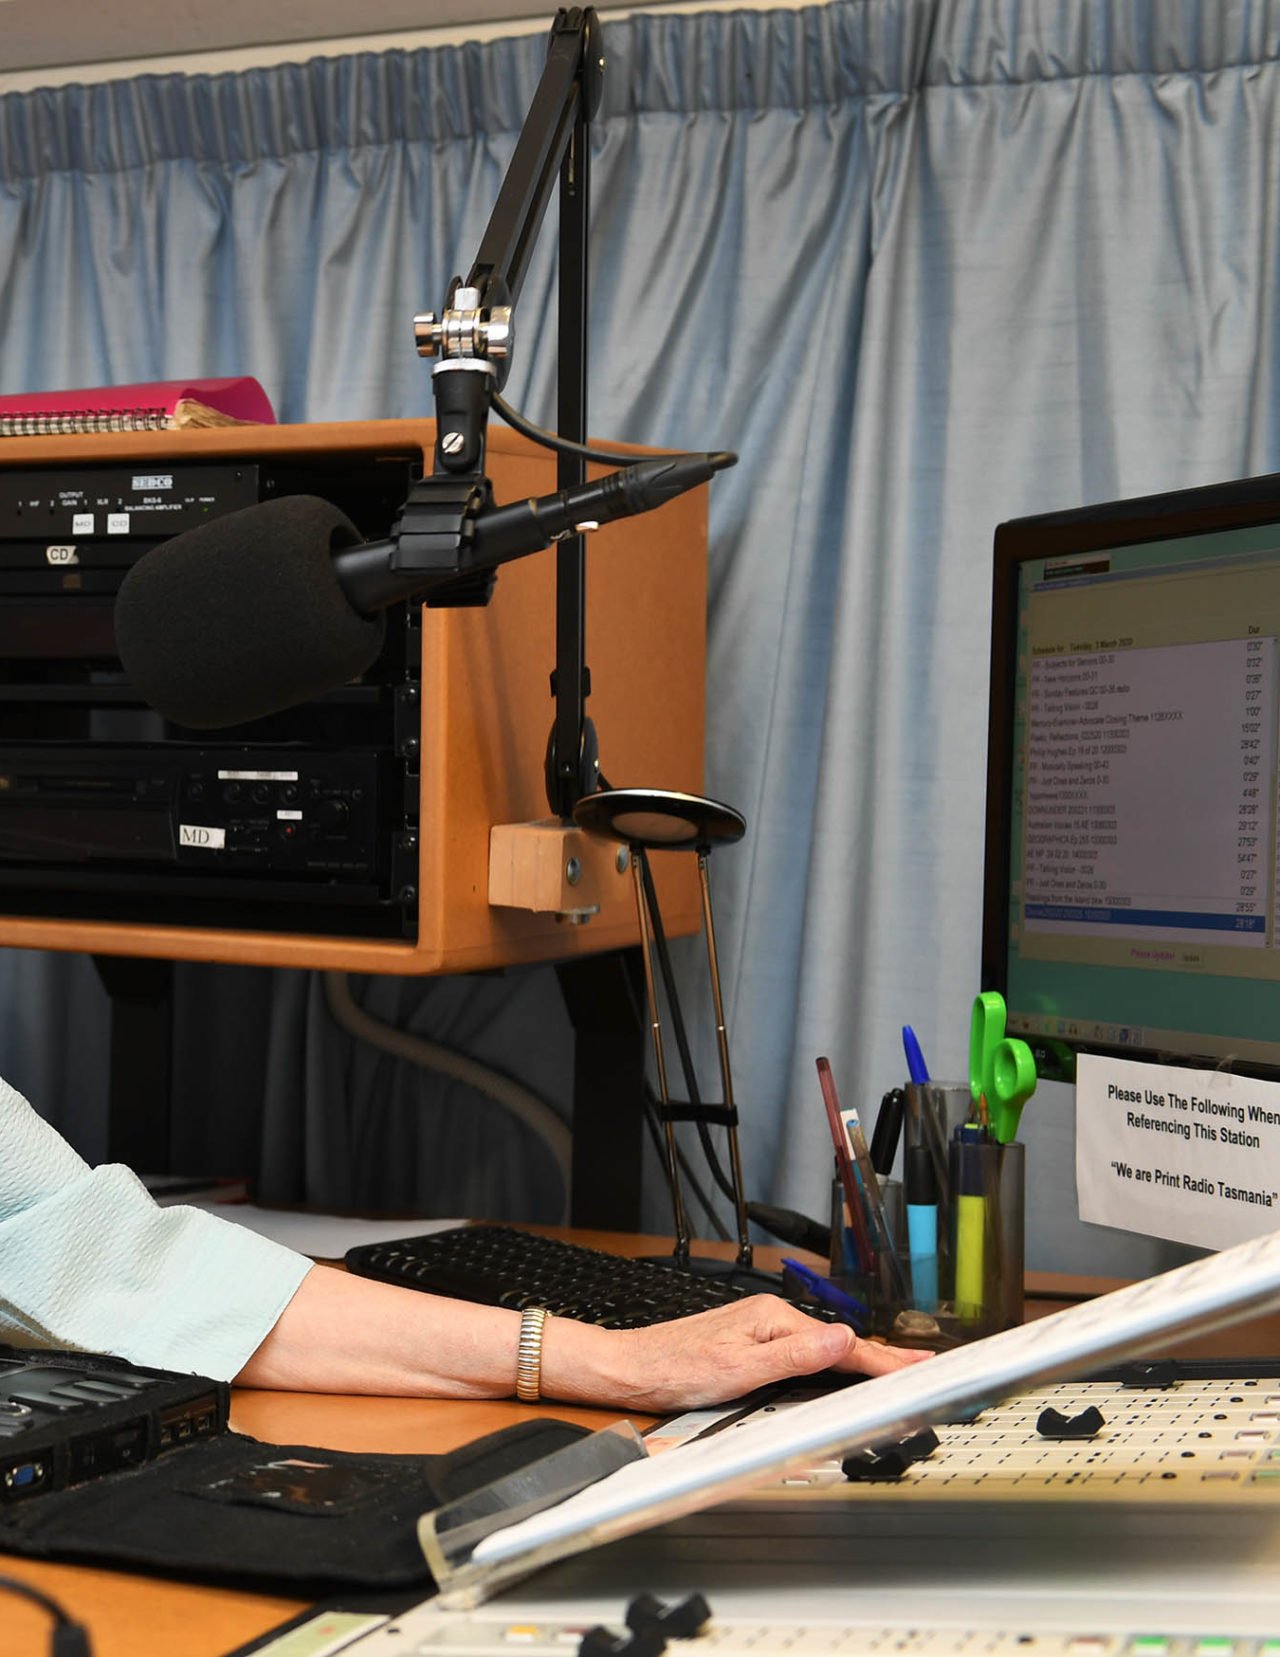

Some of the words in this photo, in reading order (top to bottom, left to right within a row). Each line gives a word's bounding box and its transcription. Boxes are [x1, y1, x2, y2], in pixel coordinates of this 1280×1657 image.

[111, 520, 128, 528] CD
[50, 548, 69, 561] CD
[182, 828, 210, 845] MD
[1108, 1084, 1142, 1103] Please
[1144, 1090, 1165, 1107] Use
[1168, 1093, 1188, 1110] The
[1191, 1097, 1245, 1123] Following
[1248, 1105, 1280, 1125] When
[1127, 1112, 1191, 1140] Referencing
[1194, 1122, 1217, 1141] This
[1220, 1127, 1260, 1149] Station
[1135, 1168, 1152, 1183] are
[1155, 1169, 1180, 1189] Print
[1183, 1175, 1215, 1195] Radio
